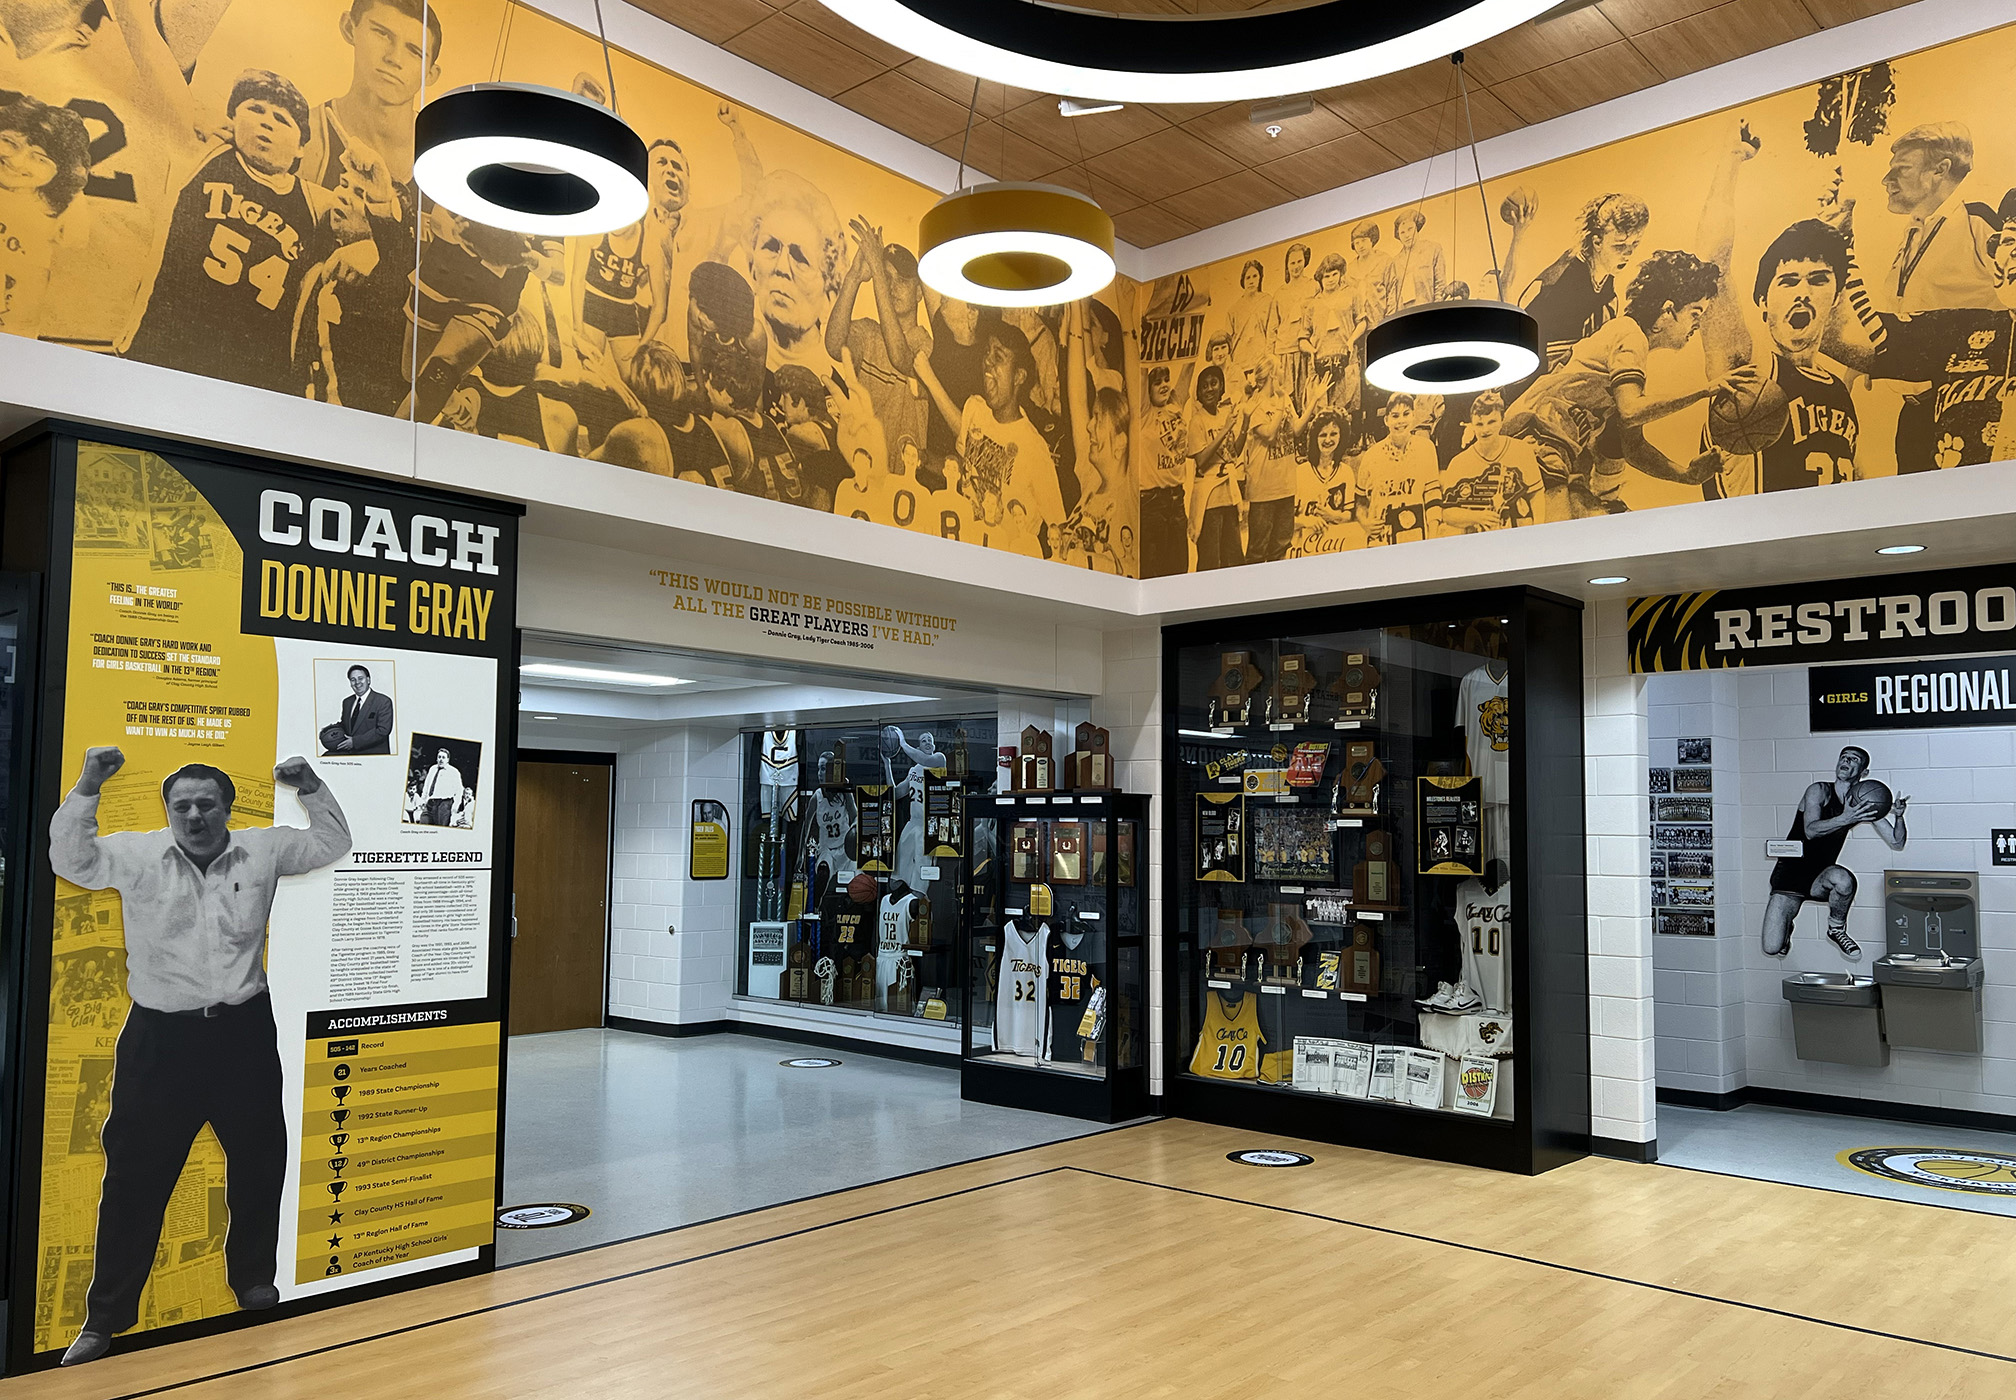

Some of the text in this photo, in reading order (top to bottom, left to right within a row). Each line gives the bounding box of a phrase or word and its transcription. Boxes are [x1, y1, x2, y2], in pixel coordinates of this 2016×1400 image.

[203, 223, 289, 310] 54
[1934, 376, 2004, 423] CLAY
[259, 489, 500, 575] COACH
[1304, 534, 1345, 553] Clay
[149, 587, 177, 598] GREATEST
[261, 559, 494, 641] DONNIE GRAY
[110, 595, 133, 606] FEELING
[135, 598, 142, 606] IN
[144, 599, 154, 608] THE
[704, 578, 763, 601] WOULD
[768, 589, 799, 607] NOT
[803, 595, 821, 611] BE
[826, 598, 892, 622] POSSIBLE
[896, 610, 957, 632] WITHOUT
[673, 595, 708, 613] ALL
[712, 601, 744, 619] THE
[750, 607, 800, 627] GREAT
[804, 614, 868, 638] PLAYERS
[1714, 585, 2016, 651] RESTROO
[116, 635, 138, 646] DONNIE
[162, 640, 178, 650] HARD
[180, 641, 199, 651] WORK
[200, 643, 211, 652] AND
[768, 630, 786, 638] Donnie
[787, 633, 802, 641] Gray,
[803, 635, 815, 643] Lady
[847, 641, 874, 649] 1985-2006
[94, 646, 220, 665] DEDICATION TO SUCCESS SET THE STANDARD
[93, 659, 104, 668] FOR
[106, 660, 124, 670] GIRLS
[125, 661, 162, 673] BASKETBALL
[163, 665, 170, 674] IN
[171, 665, 182, 674] THE
[1827, 669, 2016, 715] GIRLS REGIONAL
[170, 704, 208, 714] COMPETITIVE
[209, 706, 227, 715] SPIRIT
[228, 707, 250, 717] RUBBED
[127, 714, 231, 728] OFF ON THE REST OF US. HE MADE US
[126, 726, 213, 739] WANT TO WIN AS MUCH AS HE
[770, 746, 788, 764] C
[1220, 753, 1234, 765] CLAY
[1224, 756, 1246, 768] TIGERS
[238, 786, 252, 796] Clay
[241, 796, 263, 808] County
[826, 823, 840, 838] 23
[352, 852, 483, 863] TIGERETTE LEGEND
[883, 912, 900, 921] CLAY
[838, 926, 855, 943] 23
[885, 923, 896, 940] 12
[1472, 926, 1499, 956] 10
[1011, 959, 1042, 978] TIGERS
[1015, 980, 1036, 1002] 32
[1060, 976, 1080, 1000] 32
[66, 1001, 102, 1018] Go Big
[72, 1015, 95, 1027] Clay
[328, 1010, 447, 1030] ACCOMPLISHMENTS
[361, 1041, 384, 1050] Record
[1213, 1043, 1247, 1072] 10
[360, 1065, 377, 1073] Years
[378, 1062, 407, 1071] Coached
[359, 1081, 440, 1096] 1989 State Championship
[358, 1106, 428, 1120] 1992 State Runner-Up
[370, 1133, 392, 1143] Region
[393, 1126, 441, 1139] Championships
[372, 1156, 395, 1166] District
[397, 1149, 445, 1162] Championships
[355, 1173, 432, 1192] 1993 State Semi-Finalist
[354, 1208, 368, 1217] Clay
[370, 1204, 393, 1214] County
[405, 1199, 418, 1207] Hall
[426, 1194, 443, 1203] Fame
[366, 1227, 388, 1238] Region
[390, 1224, 402, 1232] Hall
[411, 1220, 428, 1228] Fame
[353, 1252, 362, 1260] AP
[364, 1246, 394, 1258] Kentucky
[395, 1243, 410, 1252] High
[411, 1238, 432, 1247] School
[353, 1259, 374, 1268] Coach
[394, 1251, 410, 1260] Year
